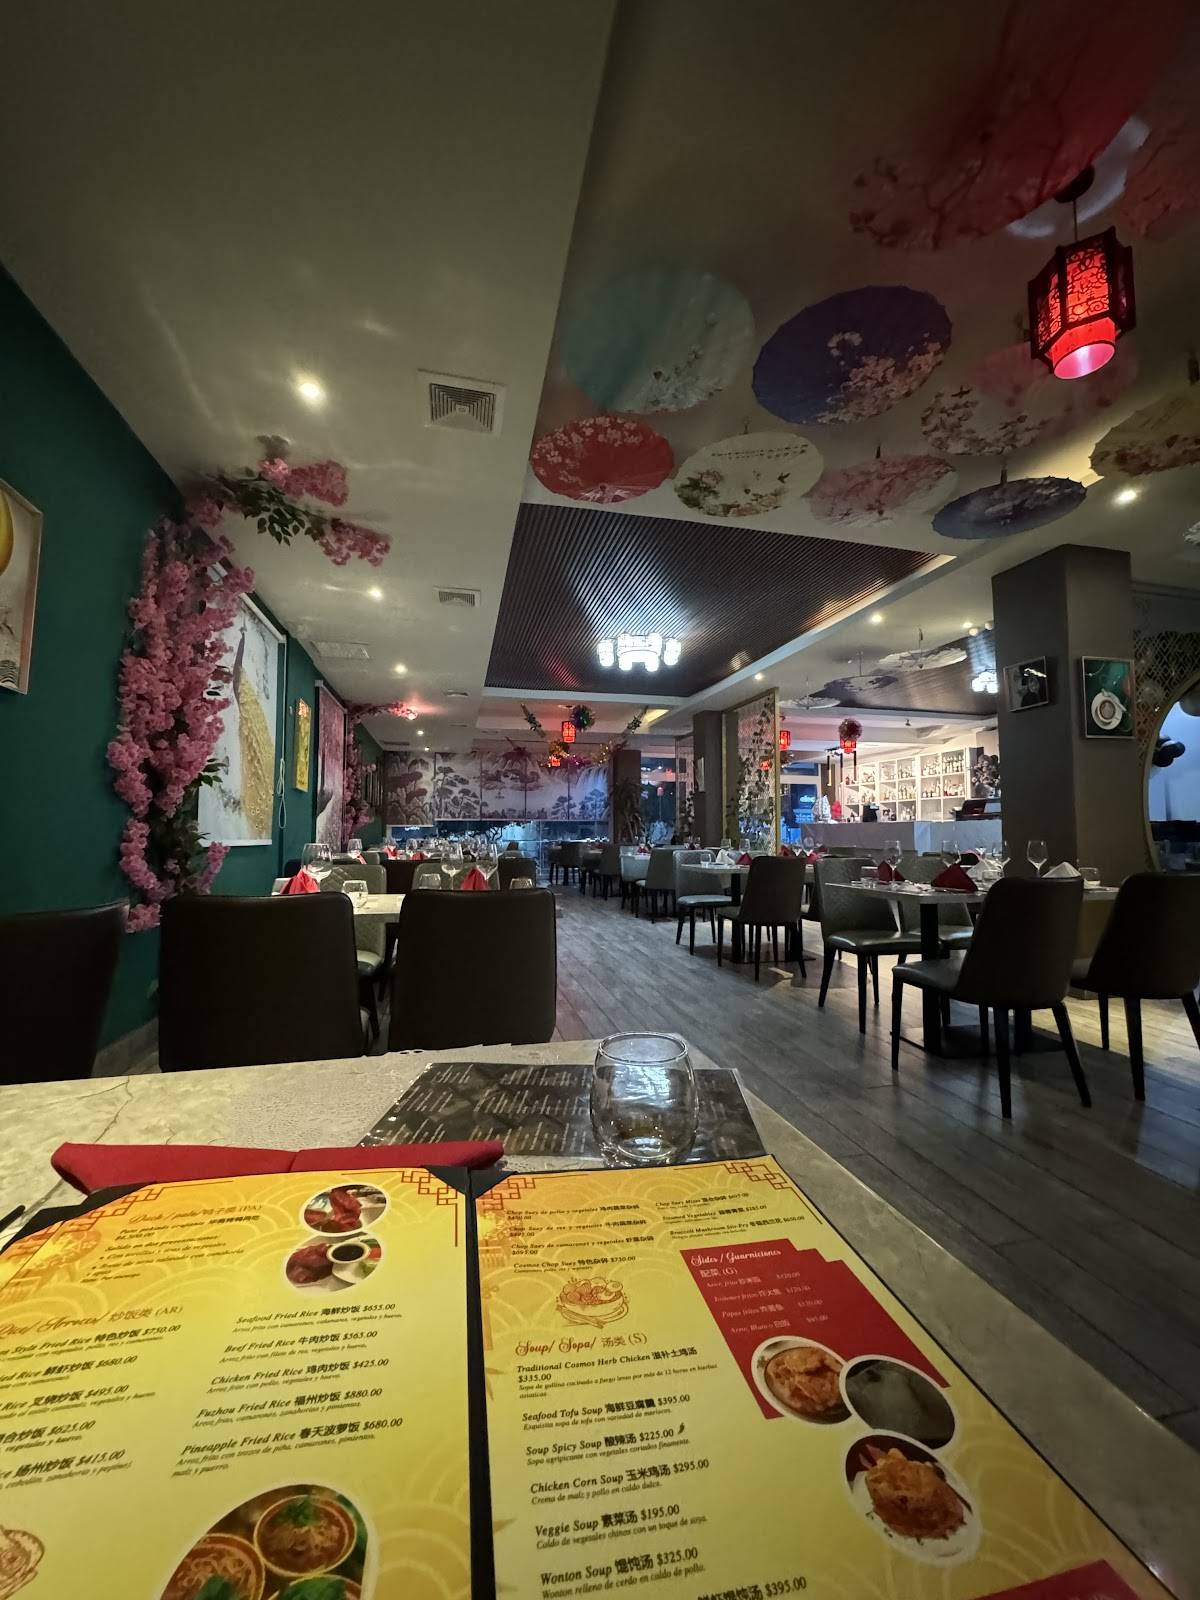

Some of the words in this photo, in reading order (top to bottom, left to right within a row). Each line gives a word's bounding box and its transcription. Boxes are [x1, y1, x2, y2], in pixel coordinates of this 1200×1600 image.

[236, 1313, 272, 1325] Seafood
[274, 1312, 297, 1320] Fried
[224, 1344, 248, 1353] Beef
[249, 1341, 273, 1350] Fried
[275, 1339, 296, 1347] Rice
[298, 1333, 340, 1345] 牛肉炒饭
[628, 1333, 648, 1345] (S)
[211, 1373, 251, 1386] Chicken
[253, 1371, 279, 1380] Fried
[282, 1368, 303, 1377] Rice
[352, 1358, 389, 1369] $425.00
[517, 1362, 562, 1373] Traditional
[564, 1360, 596, 1369] Cosmos
[597, 1356, 618, 1366] Herb
[619, 1354, 651, 1364] Chicken
[196, 1408, 236, 1419] Fuzhou
[238, 1402, 266, 1413] Fried
[269, 1399, 291, 1408] Rice
[294, 1391, 341, 1406] 福州炒饭
[344, 1388, 383, 1400] $880.00
[522, 1408, 558, 1422] Seafood
[560, 1408, 579, 1418] Tofu
[581, 1406, 603, 1416] Soup
[658, 1394, 691, 1406] $395.00
[181, 1440, 239, 1456] Pineapple
[240, 1434, 270, 1447] Fried
[272, 1431, 296, 1442] Rice
[363, 1418, 404, 1431] $680.00
[526, 1446, 550, 1456] Soup
[552, 1443, 577, 1454] Spicy
[579, 1440, 602, 1450] Soup
[639, 1429, 674, 1442] $225.00
[530, 1480, 570, 1494] Chicken
[573, 1478, 598, 1488] Corn
[600, 1474, 624, 1486] Soup
[625, 1464, 671, 1482] 玉米鸡汤
[673, 1458, 710, 1473] $295.00
[535, 1521, 570, 1537] Veggie
[573, 1517, 599, 1533] Soup
[640, 1504, 680, 1522] $195.00
[561, 1535, 571, 1545] de
[540, 1566, 583, 1585] Wonton
[585, 1562, 612, 1581] Soup
[656, 1547, 699, 1565] $325.00
[542, 1586, 574, 1599] Wonton
[575, 1581, 603, 1596] relleno
[604, 1579, 614, 1590] de
[615, 1574, 638, 1587] cerdo
[640, 1573, 649, 1584] en
[650, 1568, 672, 1581] caldo
[673, 1567, 683, 1577] de
[764, 1575, 808, 1598] $395.00
